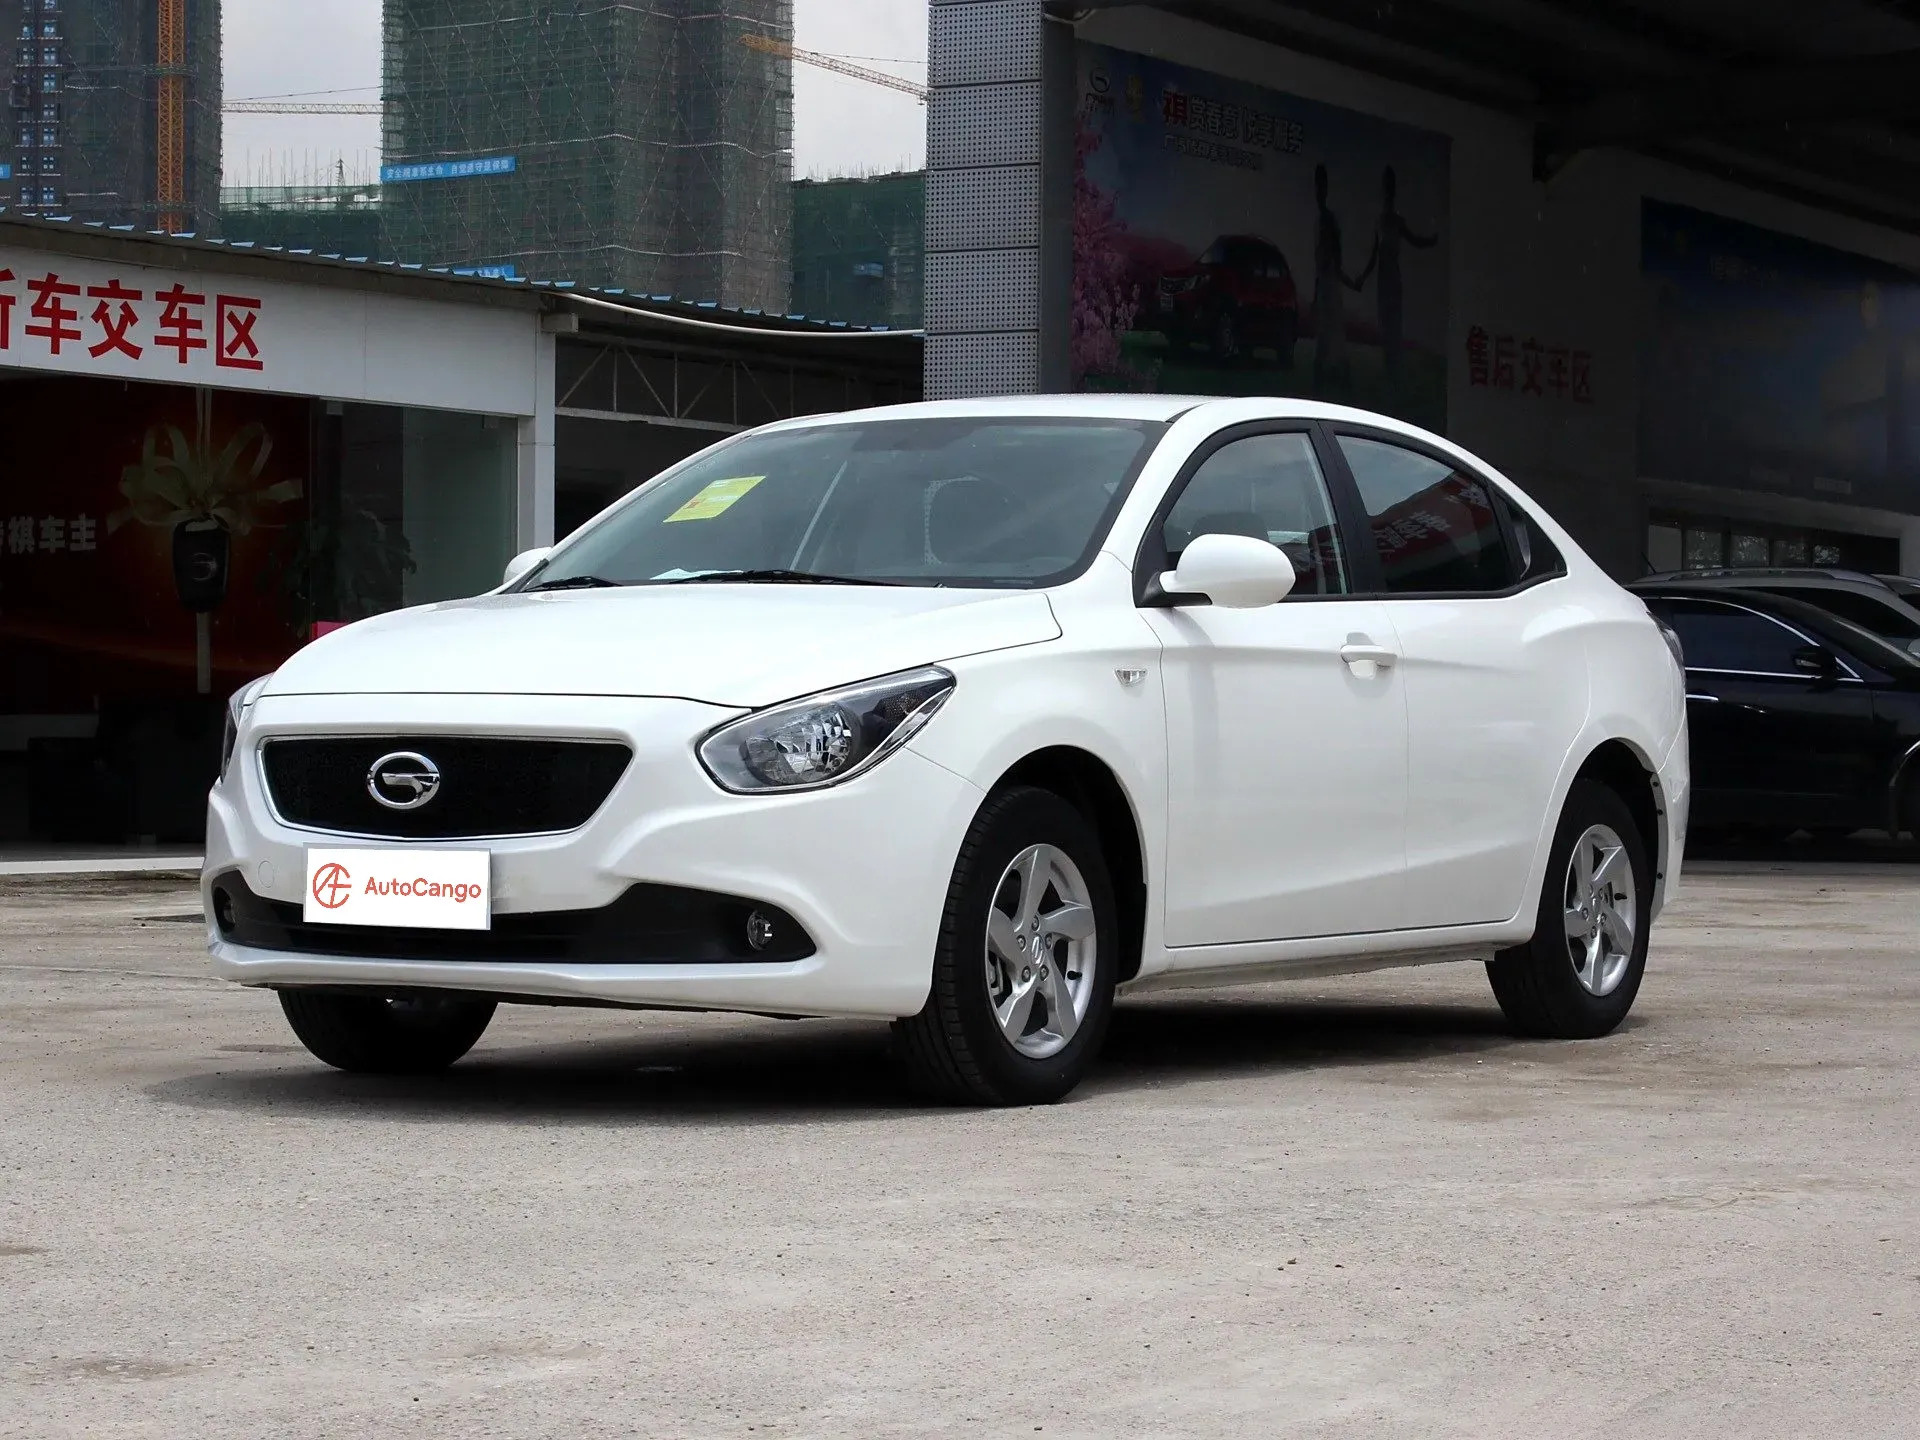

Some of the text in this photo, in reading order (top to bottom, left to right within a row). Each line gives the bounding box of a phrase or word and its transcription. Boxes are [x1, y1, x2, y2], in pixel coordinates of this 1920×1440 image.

[0, 268, 263, 371] 车交车区
[1467, 325, 1595, 404] 售后交车区
[0, 513, 96, 554] 祺车主
